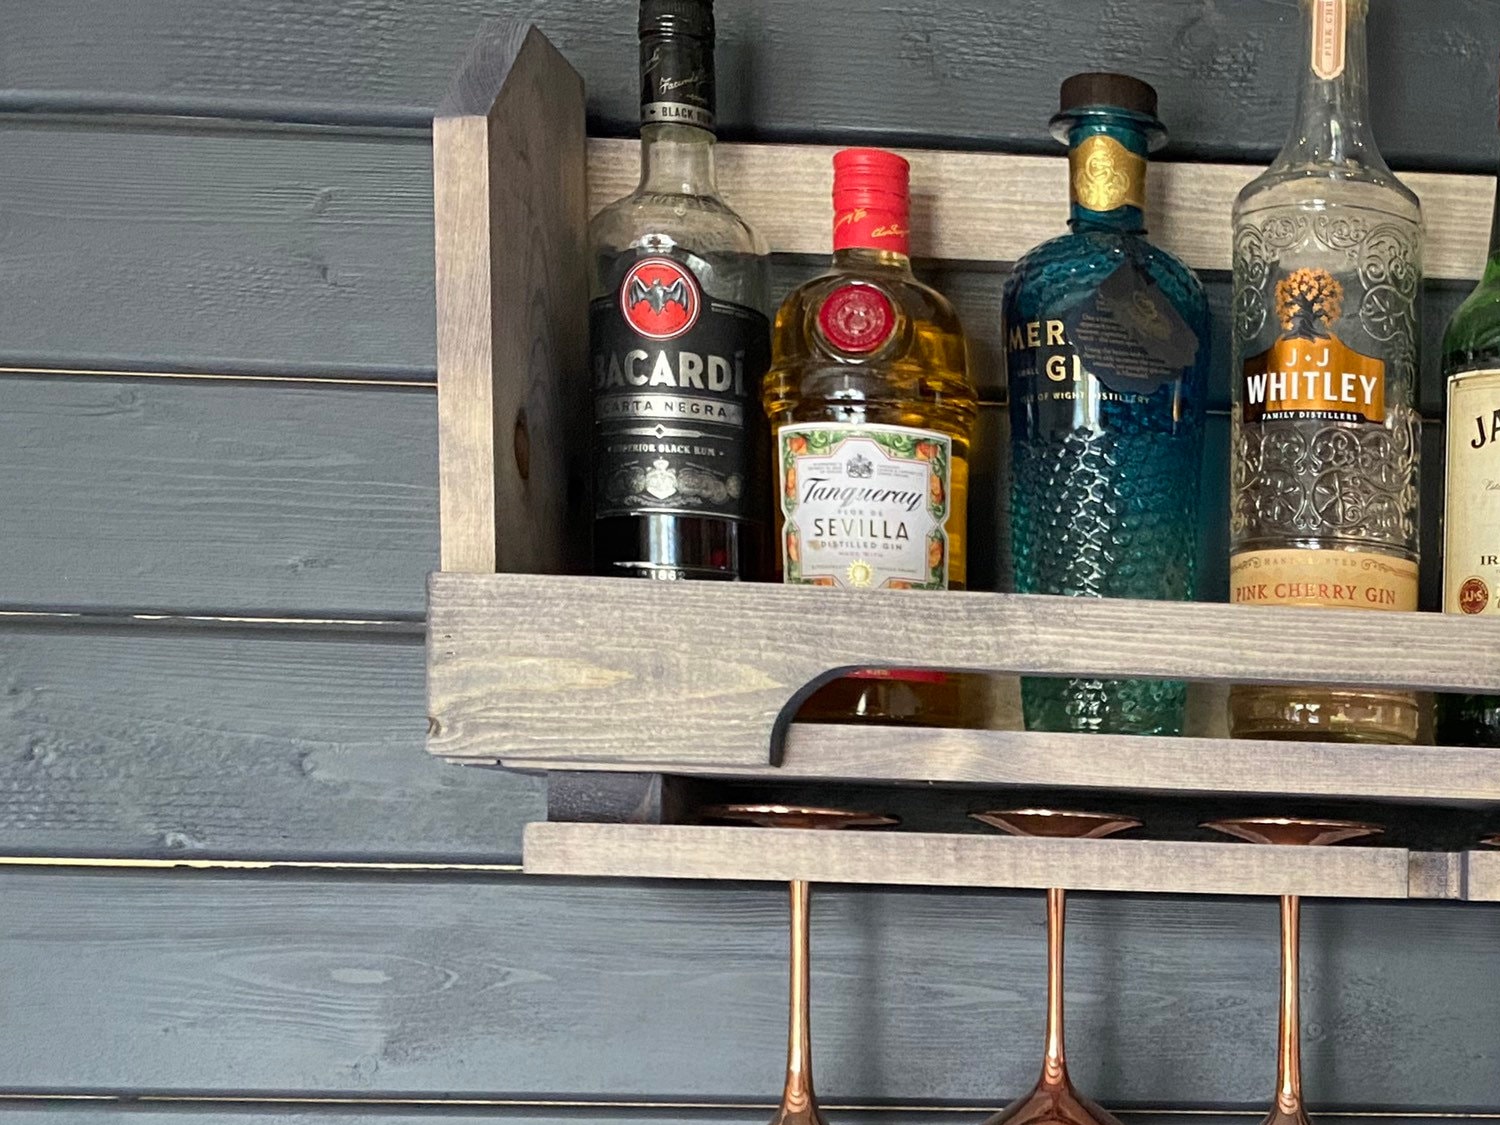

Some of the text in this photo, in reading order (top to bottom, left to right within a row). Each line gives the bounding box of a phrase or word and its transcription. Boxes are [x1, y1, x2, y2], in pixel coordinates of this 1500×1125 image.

[662, 106, 694, 120] BLACK
[1008, 319, 1073, 351] MER
[1053, 391, 1085, 400] WIGHT
[1247, 371, 1377, 405] WHITLEY
[664, 402, 728, 417] NEGRA
[1262, 411, 1358, 421] FAMILY DISTILLERS
[658, 444, 690, 454] BLACK
[694, 447, 715, 456] RUM
[802, 478, 923, 512] Tanqueray
[814, 518, 909, 540] SEVILLA
[820, 541, 903, 551] DISTILLED GIN
[1236, 583, 1396, 604] PINK CHERRY GIN
